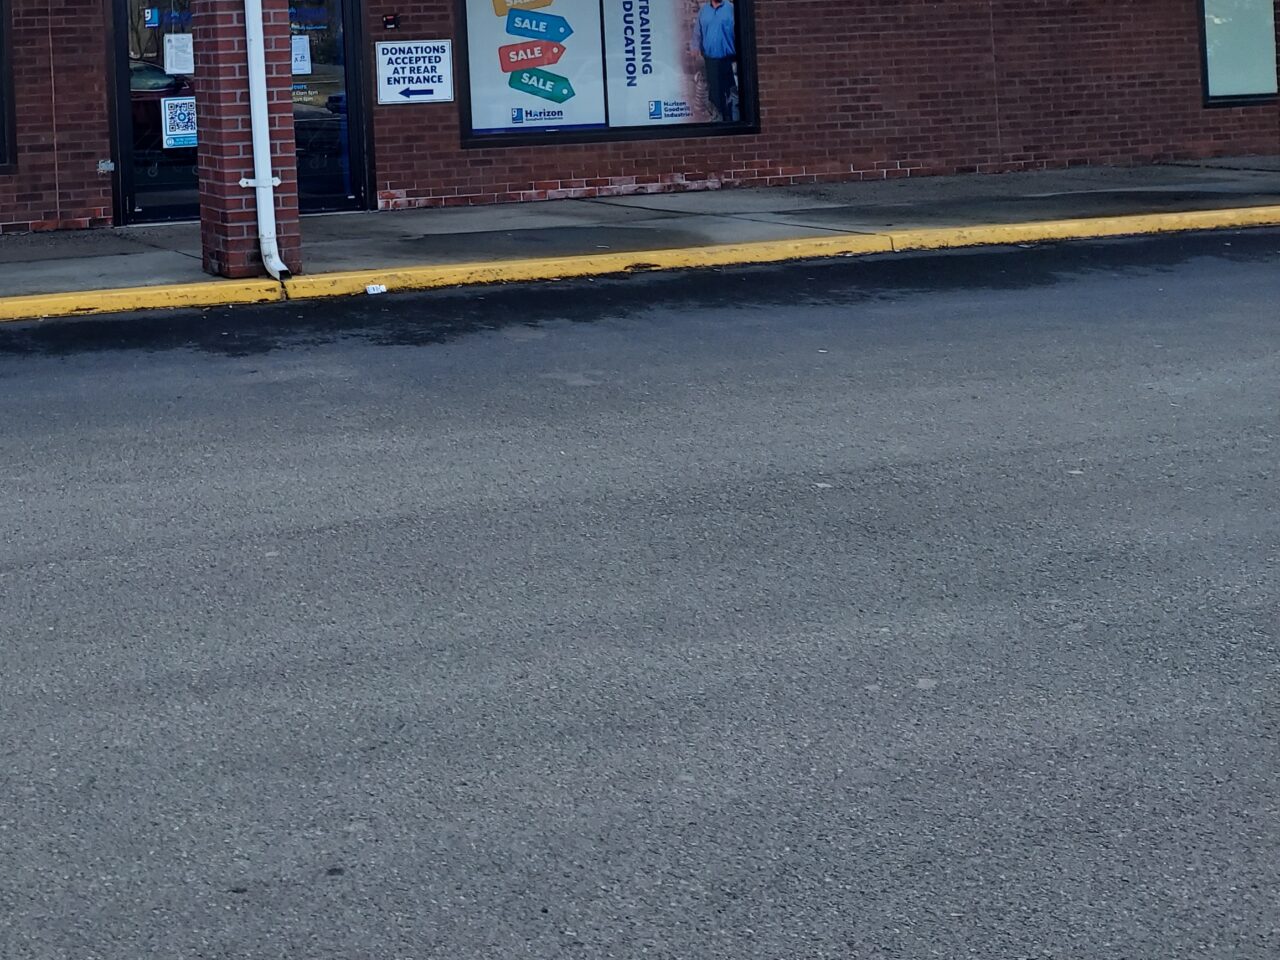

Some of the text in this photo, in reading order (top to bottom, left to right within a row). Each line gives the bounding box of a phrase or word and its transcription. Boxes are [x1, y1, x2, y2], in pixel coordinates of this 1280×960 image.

[514, 17, 547, 32] SALE
[382, 45, 446, 56] DONATIONS
[509, 47, 542, 62] SALE
[387, 56, 442, 65] ACCEPTED
[392, 66, 437, 75] AT REAR
[387, 75, 443, 85] ENTRANCE
[521, 73, 554, 92] SALE
[525, 109, 563, 118] Horizon
